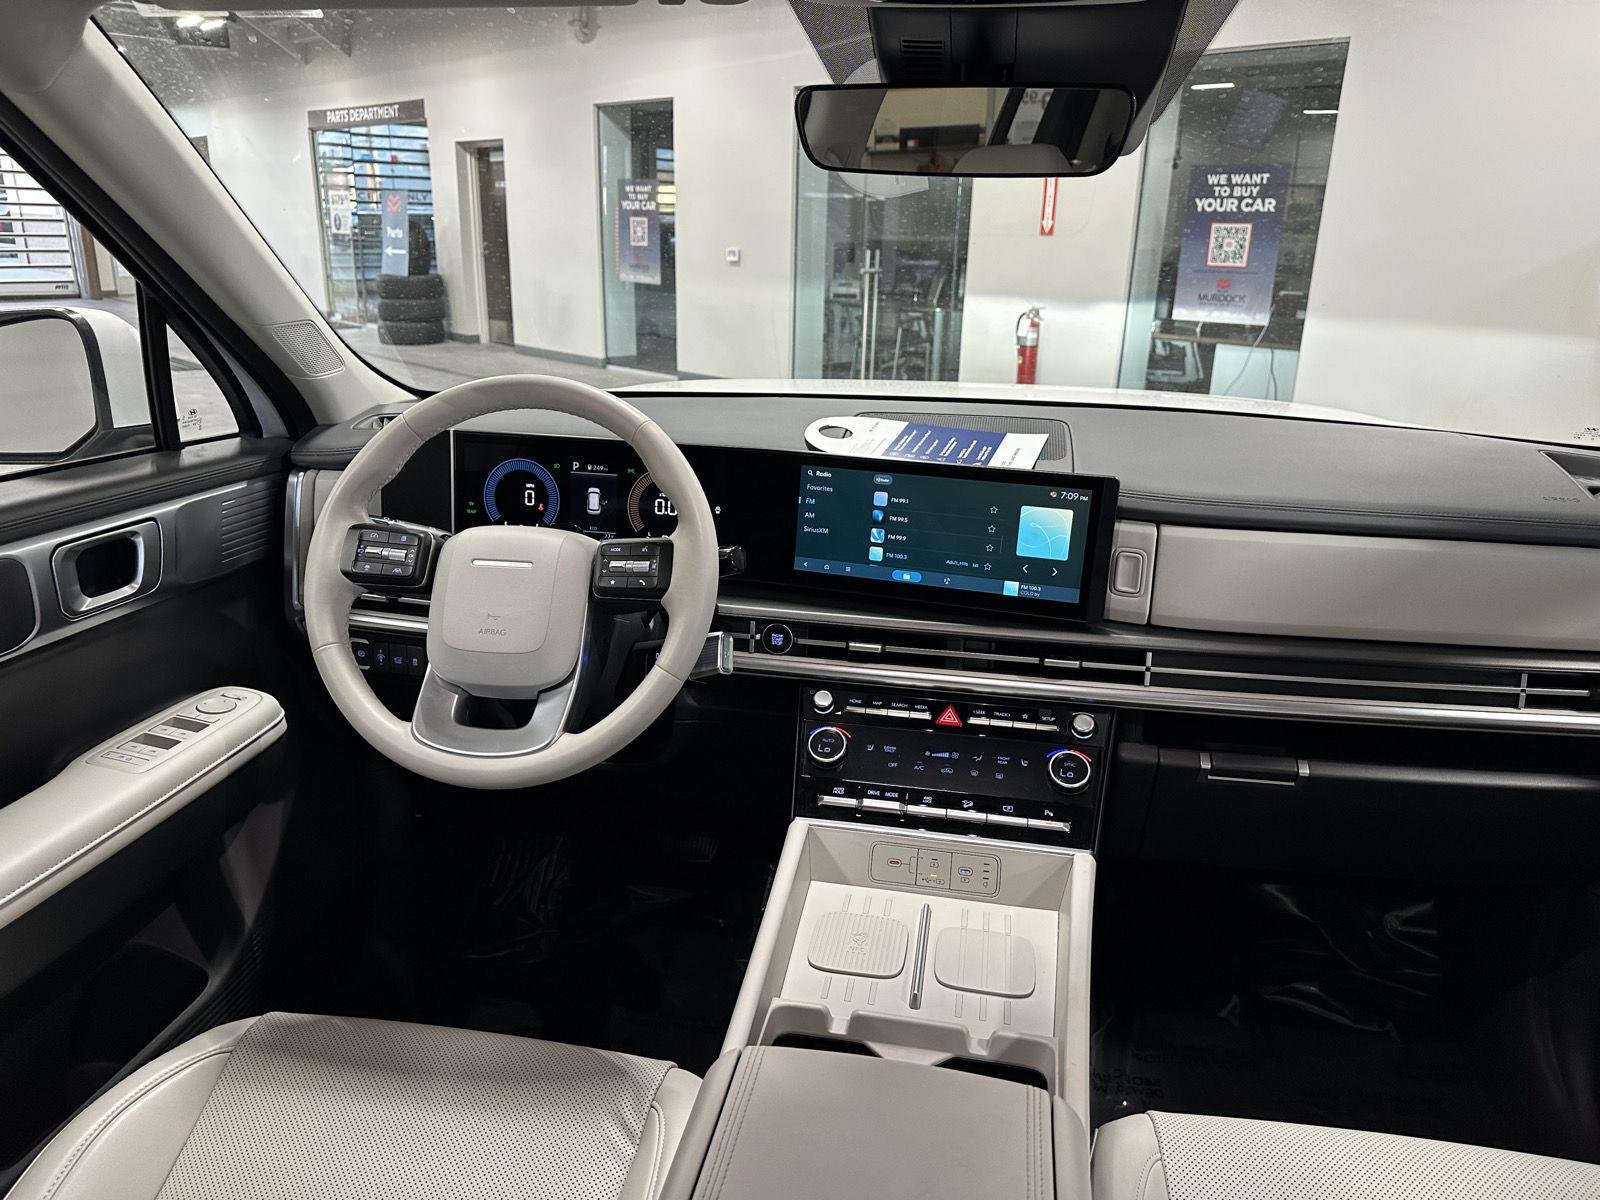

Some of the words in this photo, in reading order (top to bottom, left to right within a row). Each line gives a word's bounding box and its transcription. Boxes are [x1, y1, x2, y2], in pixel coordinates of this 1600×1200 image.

[326, 109, 348, 124] PARTS
[350, 104, 400, 121] DEPARTMENT
[1207, 174, 1228, 186] WE
[1230, 173, 1270, 185] WANT
[624, 184, 634, 192] WE
[636, 184, 652, 192] WANT
[1214, 186, 1231, 197] TO
[1233, 186, 1260, 197] BUY
[621, 200, 640, 210] YOUR
[641, 200, 656, 211] CAR
[1194, 198, 1238, 212] YOUR
[1240, 198, 1276, 213] CAR
[572, 462, 580, 470] P
[592, 464, 604, 472] 249
[816, 470, 832, 478] Radio
[806, 484, 833, 492] Favorites
[524, 489, 535, 506] 0
[1060, 491, 1079, 501] 7:09
[803, 526, 829, 534] SiriusXM
[478, 628, 507, 636] AIRBAG
[818, 744, 831, 753] Lo
[1060, 768, 1074, 778] Lo
